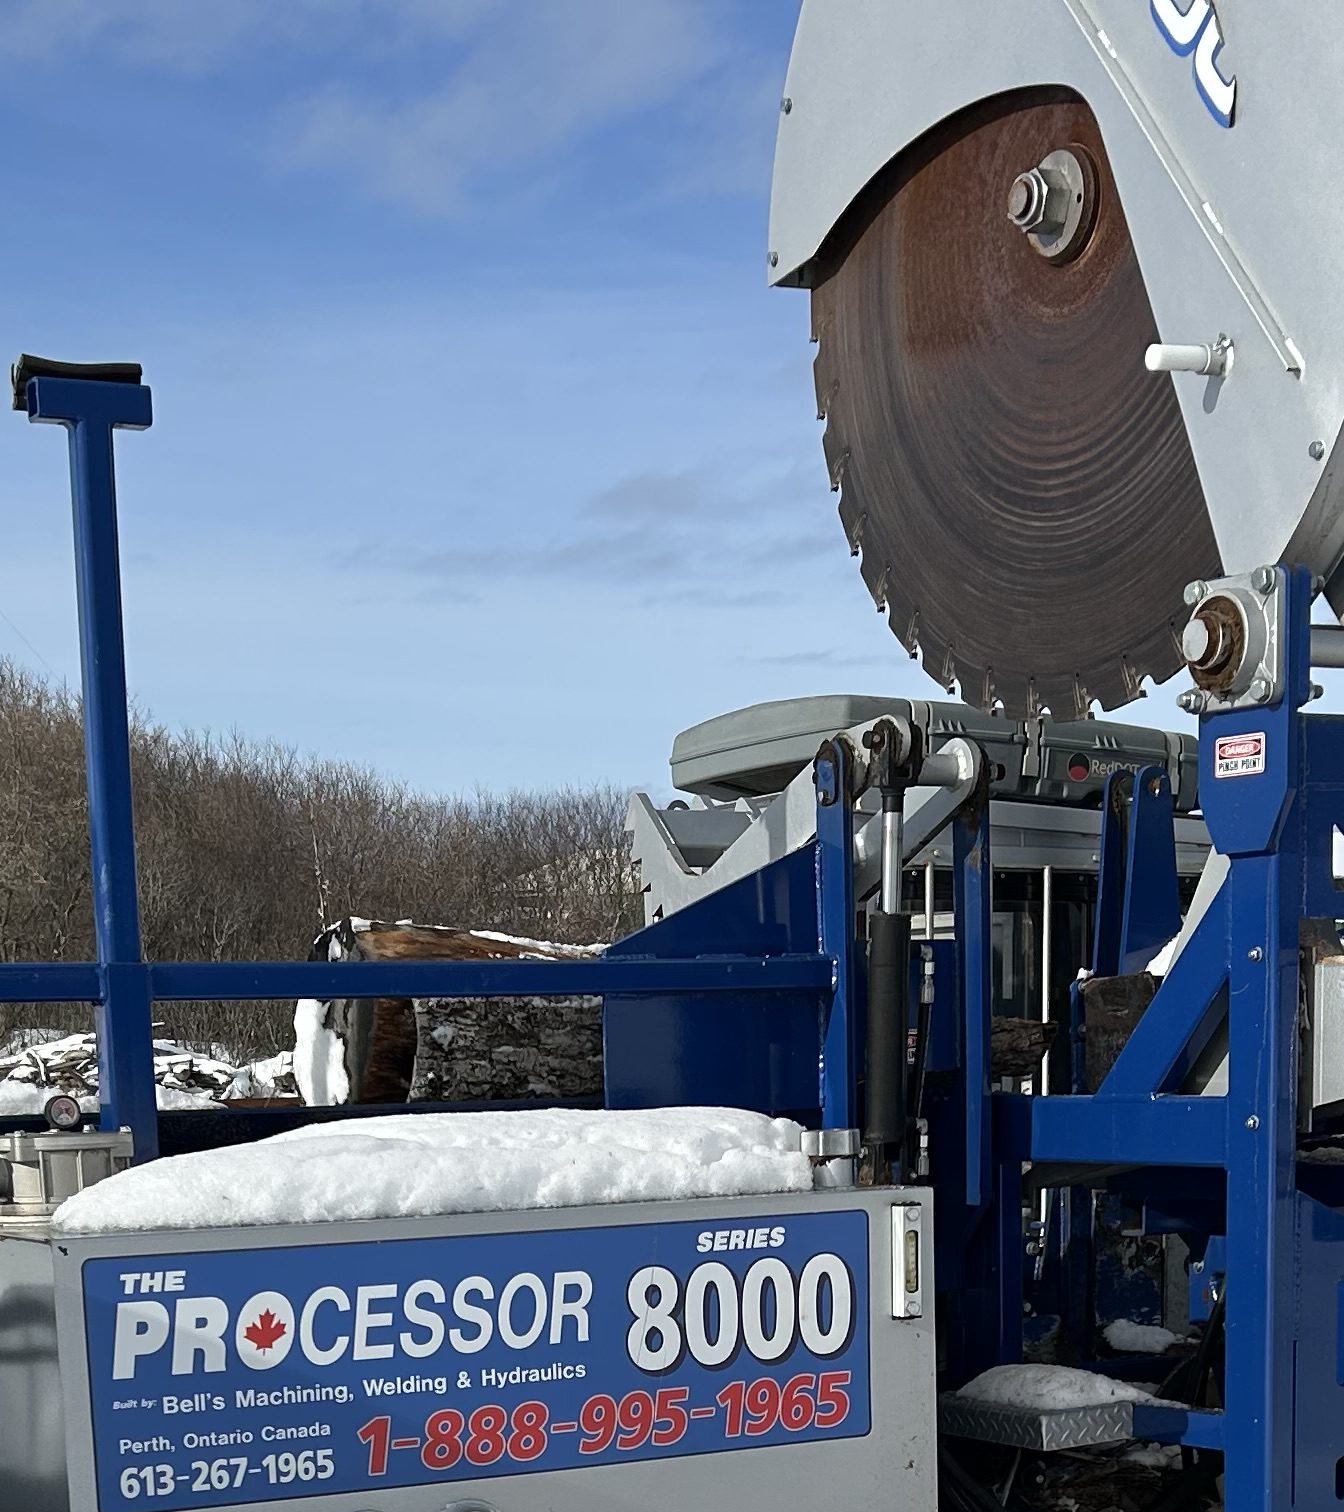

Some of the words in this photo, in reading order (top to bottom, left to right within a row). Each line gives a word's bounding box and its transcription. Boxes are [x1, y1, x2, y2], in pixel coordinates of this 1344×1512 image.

[1219, 760, 1238, 772] PINCH
[1241, 758, 1260, 769] POINT
[697, 1227, 785, 1252] SERIES
[119, 1270, 186, 1294] THE
[112, 1270, 593, 1380] PROCESSOR
[627, 1252, 854, 1372] 8000
[162, 1393, 226, 1414] Bell's
[235, 1383, 354, 1408] Machining,
[362, 1375, 447, 1397] Welding
[456, 1371, 472, 1389] &
[481, 1362, 587, 1389] Hydraulics
[119, 1436, 176, 1454] Perth,
[183, 1429, 254, 1449] Ontario
[261, 1421, 331, 1442] Canada
[356, 1370, 851, 1476] 1-888-995-1965
[119, 1448, 335, 1499] 613-267-1965
